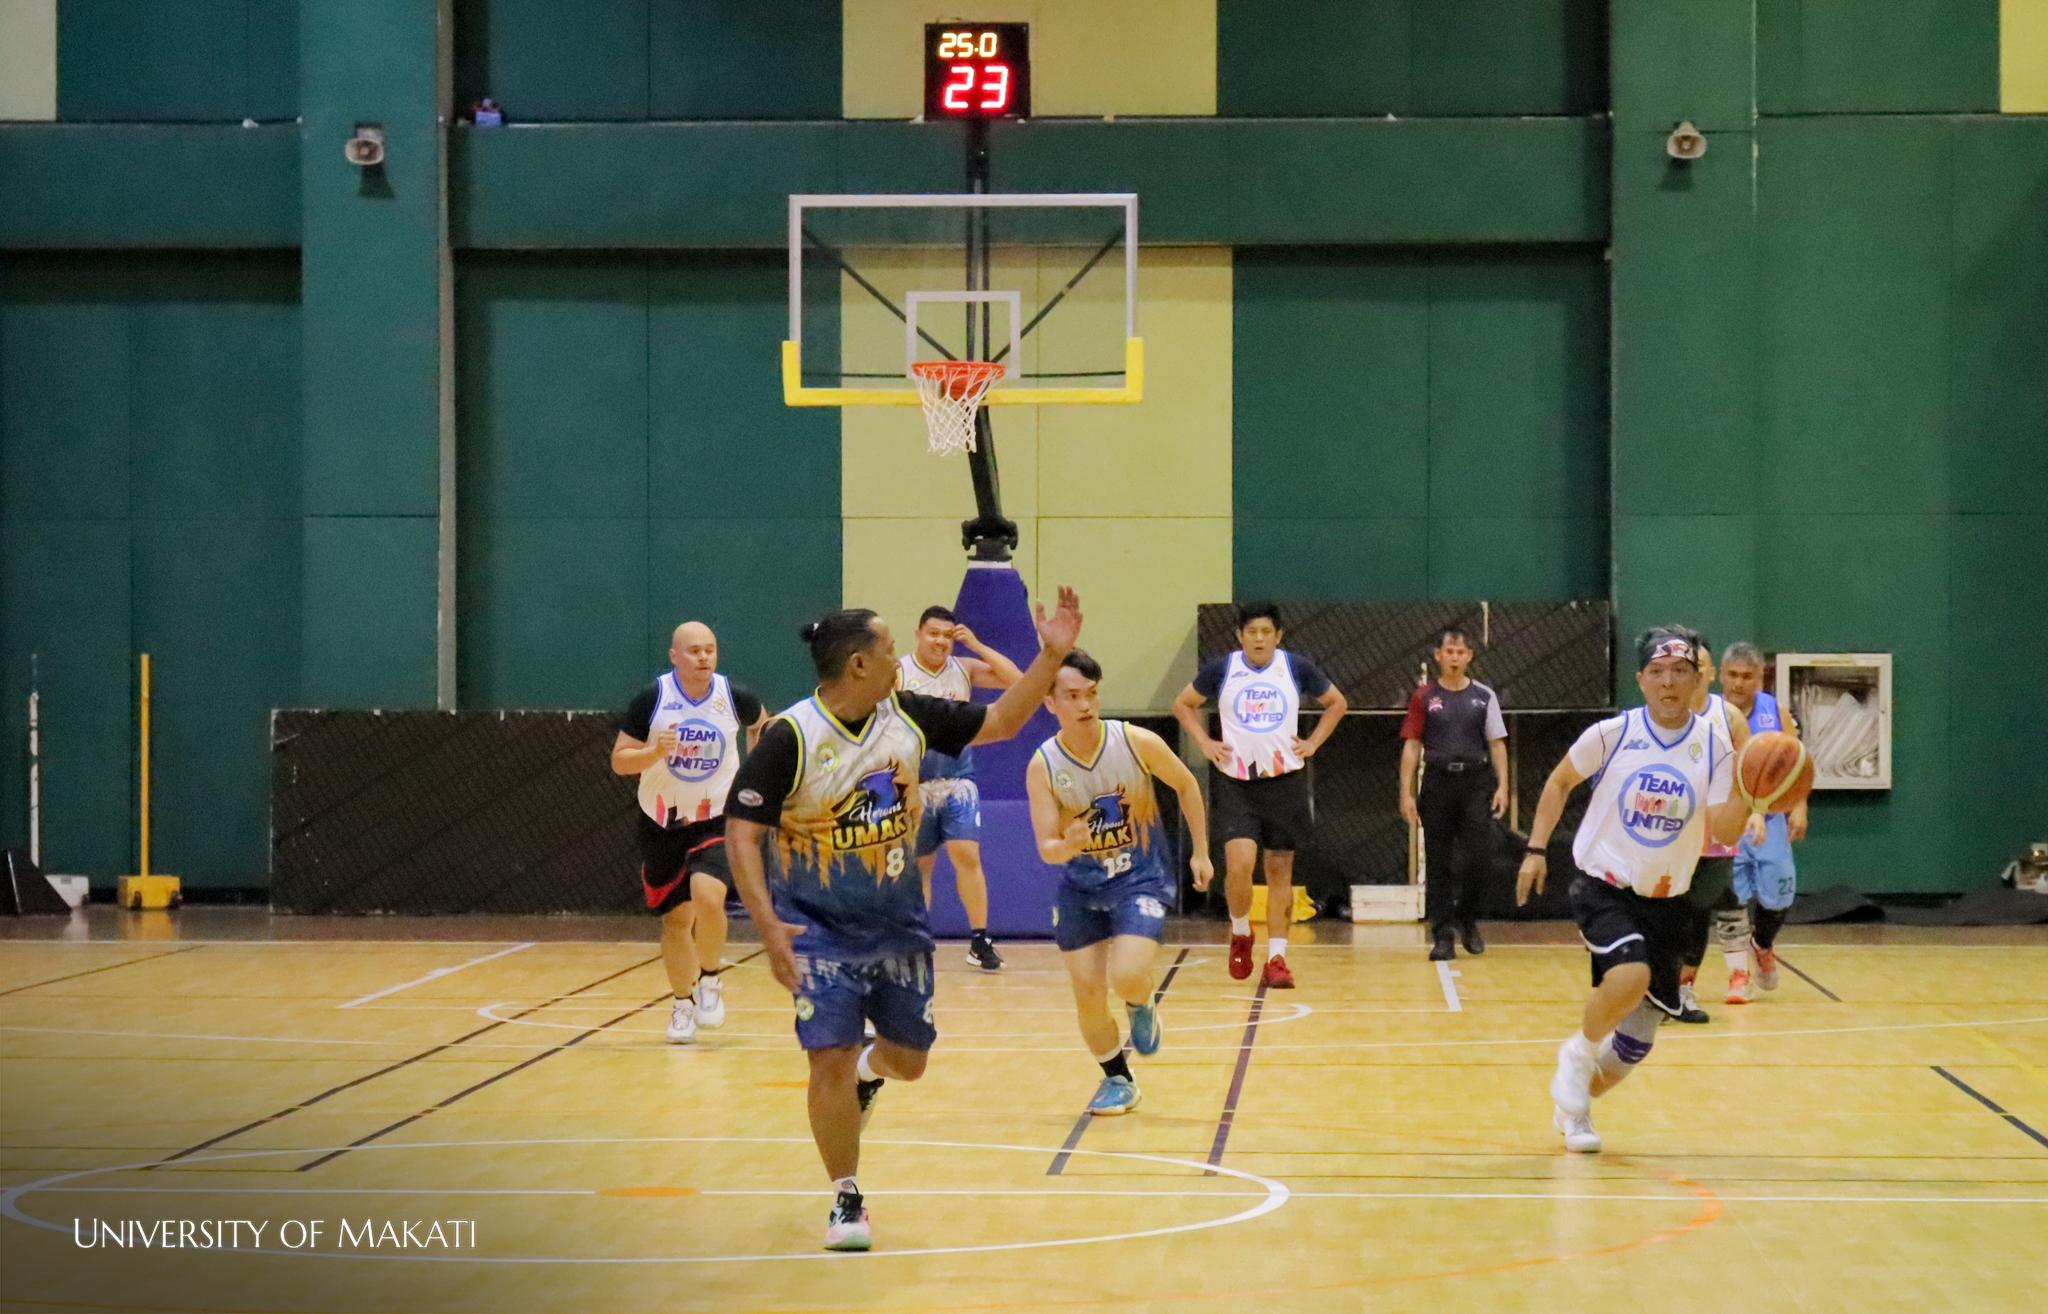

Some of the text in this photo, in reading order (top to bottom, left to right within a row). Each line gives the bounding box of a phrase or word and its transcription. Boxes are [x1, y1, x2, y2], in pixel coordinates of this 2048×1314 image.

[939, 32, 998, 58] 25.0
[944, 65, 1009, 109] 23
[1244, 689, 1277, 700] TEAM
[1238, 712, 1284, 724] UNITED
[678, 727, 716, 742] TEAM
[667, 755, 720, 771] UNITED
[1638, 773, 1686, 797] TEAM
[833, 813, 907, 850] UMAK
[1622, 808, 1684, 832] UNITED
[1086, 825, 1131, 851] MAK
[886, 847, 905, 877] 8
[1103, 852, 1132, 879] 18
